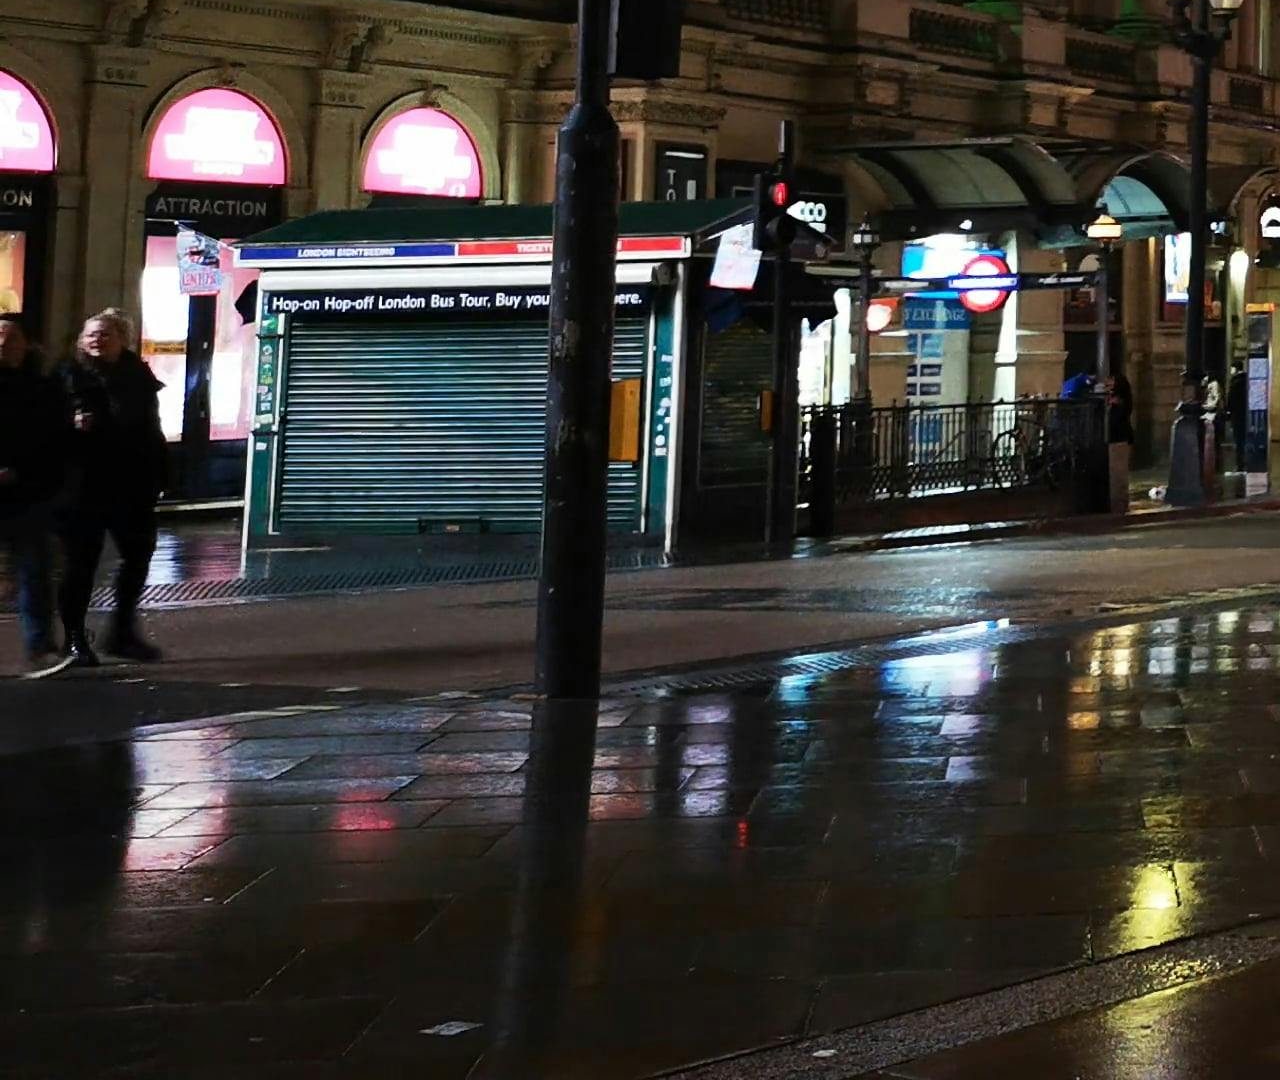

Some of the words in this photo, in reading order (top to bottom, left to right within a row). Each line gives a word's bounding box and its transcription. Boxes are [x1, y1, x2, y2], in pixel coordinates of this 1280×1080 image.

[155, 196, 268, 217] ATTRACTION
[272, 296, 320, 313] Hop-on
[324, 295, 375, 313] Hop-off
[378, 295, 425, 310] London
[430, 294, 455, 308] Bus
[459, 293, 491, 309] Tour,
[495, 292, 521, 310] Buy
[525, 294, 550, 309] you
